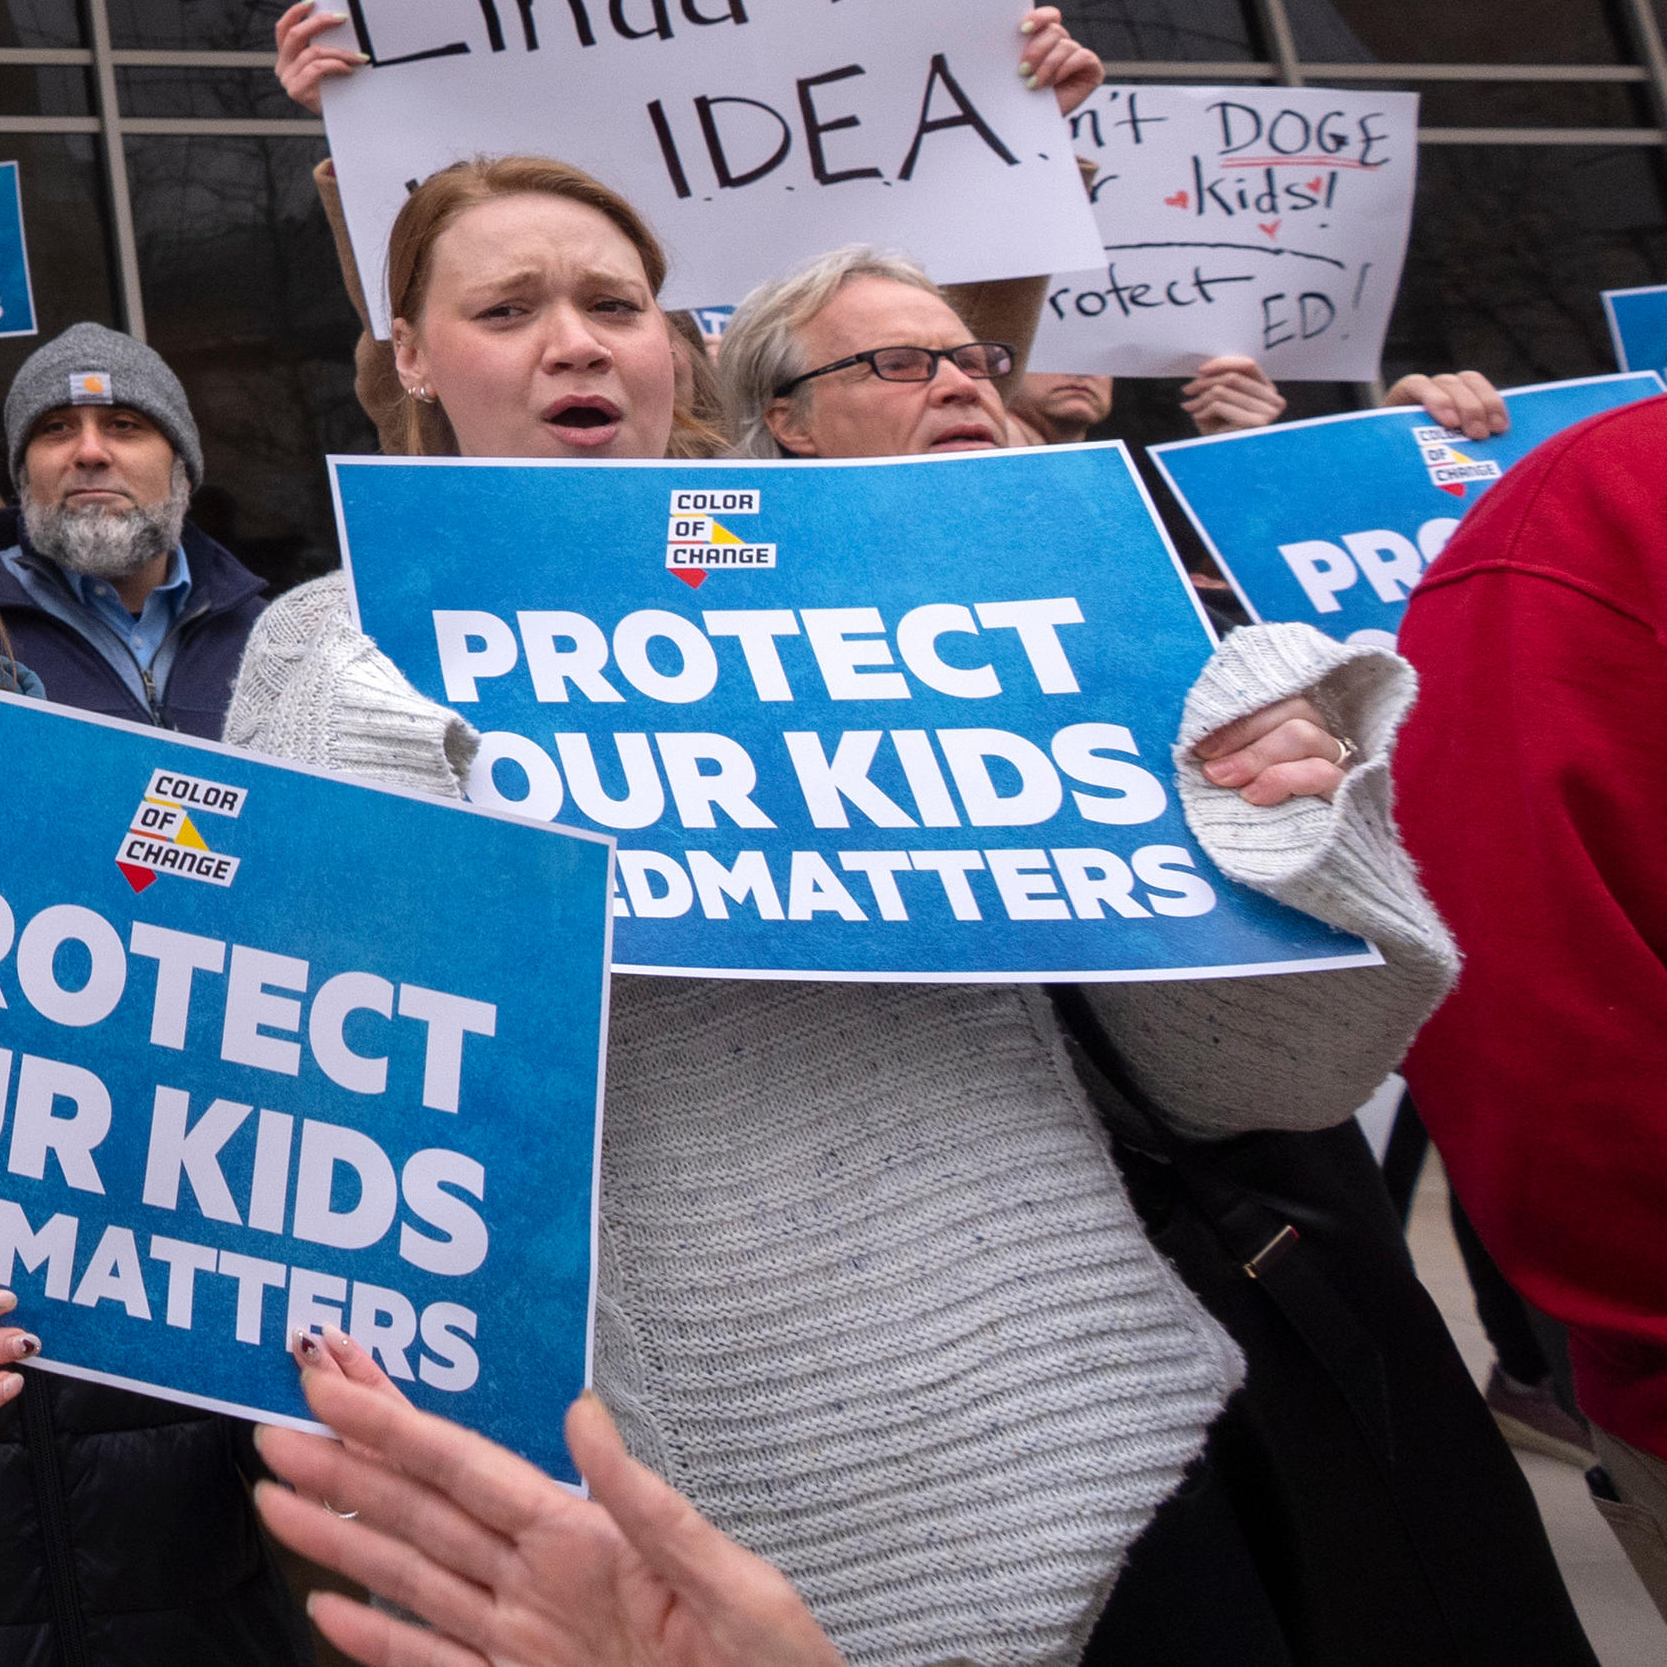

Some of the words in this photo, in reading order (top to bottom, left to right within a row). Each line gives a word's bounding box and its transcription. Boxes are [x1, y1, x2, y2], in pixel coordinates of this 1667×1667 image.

[1205, 101, 1390, 166] DOGE
[1192, 155, 1338, 228] kids!
[677, 494, 753, 510] COLOR
[675, 521, 705, 537] OF
[673, 548, 768, 564] CHANGE
[431, 598, 1085, 705] PROTECT
[155, 776, 238, 811] COLOR
[470, 730, 776, 830] OUR
[789, 721, 1168, 829] KIDS
[141, 808, 177, 830] OF
[126, 840, 231, 880] CHANGE
[141, 1084, 489, 1275] KIDS
